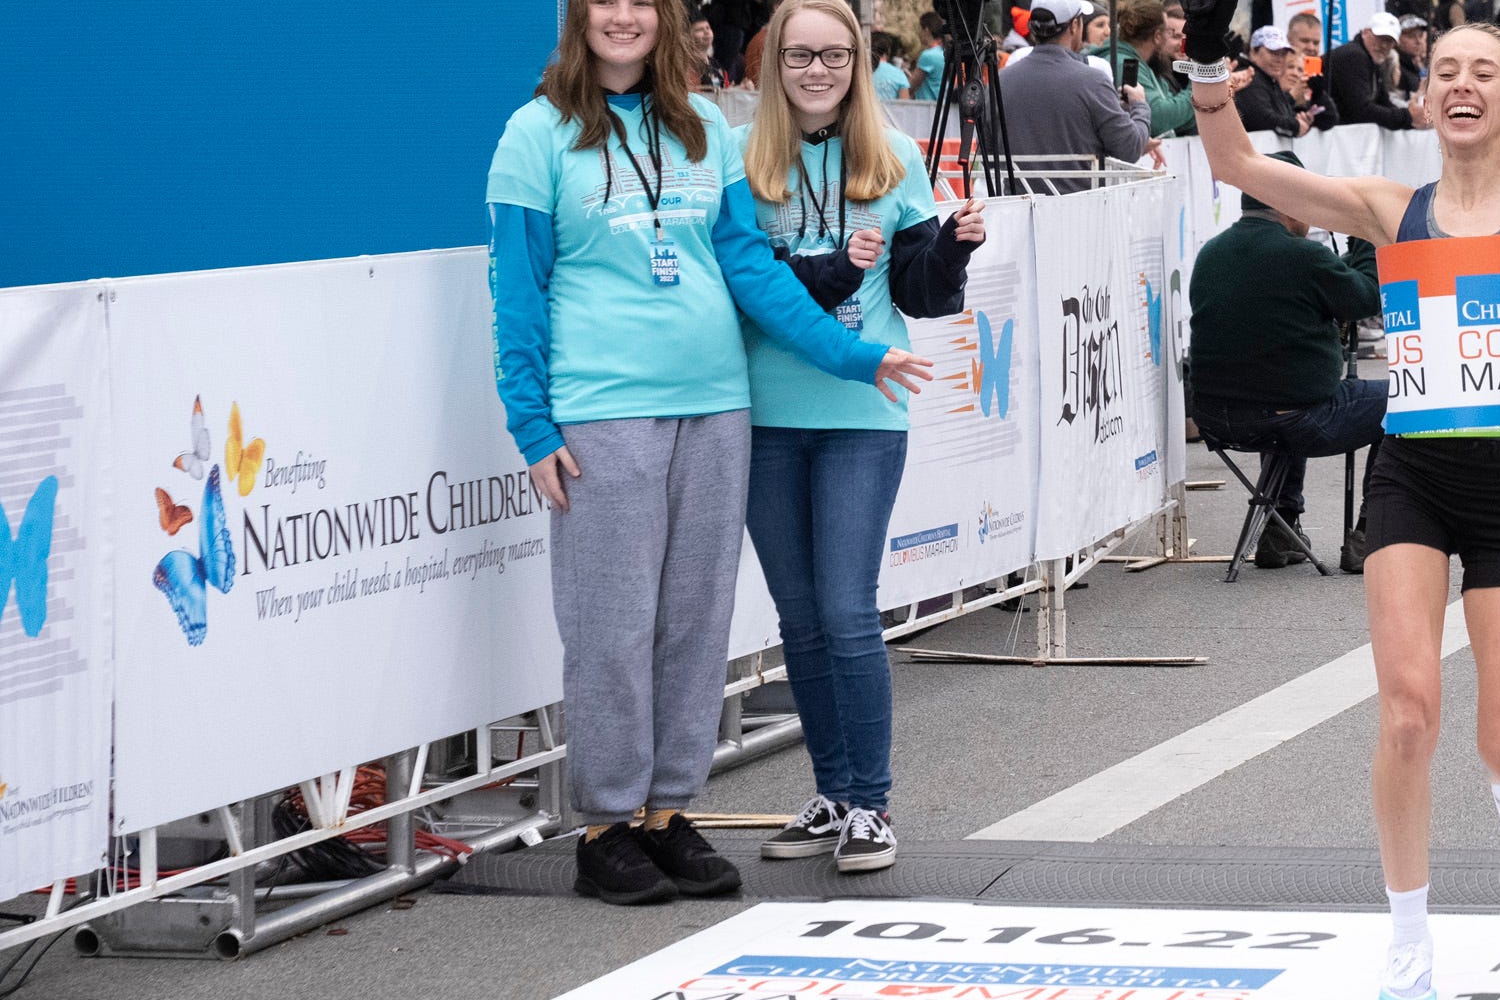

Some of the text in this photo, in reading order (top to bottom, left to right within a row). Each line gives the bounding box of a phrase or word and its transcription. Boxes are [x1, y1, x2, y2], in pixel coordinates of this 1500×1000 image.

[661, 197, 682, 205] OUR
[651, 259, 679, 268] START
[651, 267, 680, 276] FINISH
[836, 305, 862, 313] START
[836, 313, 863, 321] FINISH
[264, 450, 327, 494] Benefiting
[241, 470, 551, 577] NATIONWIDE CHILDREN
[925, 539, 958, 559] MARATHON
[256, 537, 546, 623] When your child needs a hospital, everything matters.
[798, 920, 1337, 950] 10.16.22
[727, 965, 1249, 989] CHILDREN'S HOSPITAL
[844, 958, 1166, 977] NATIONWIDE
